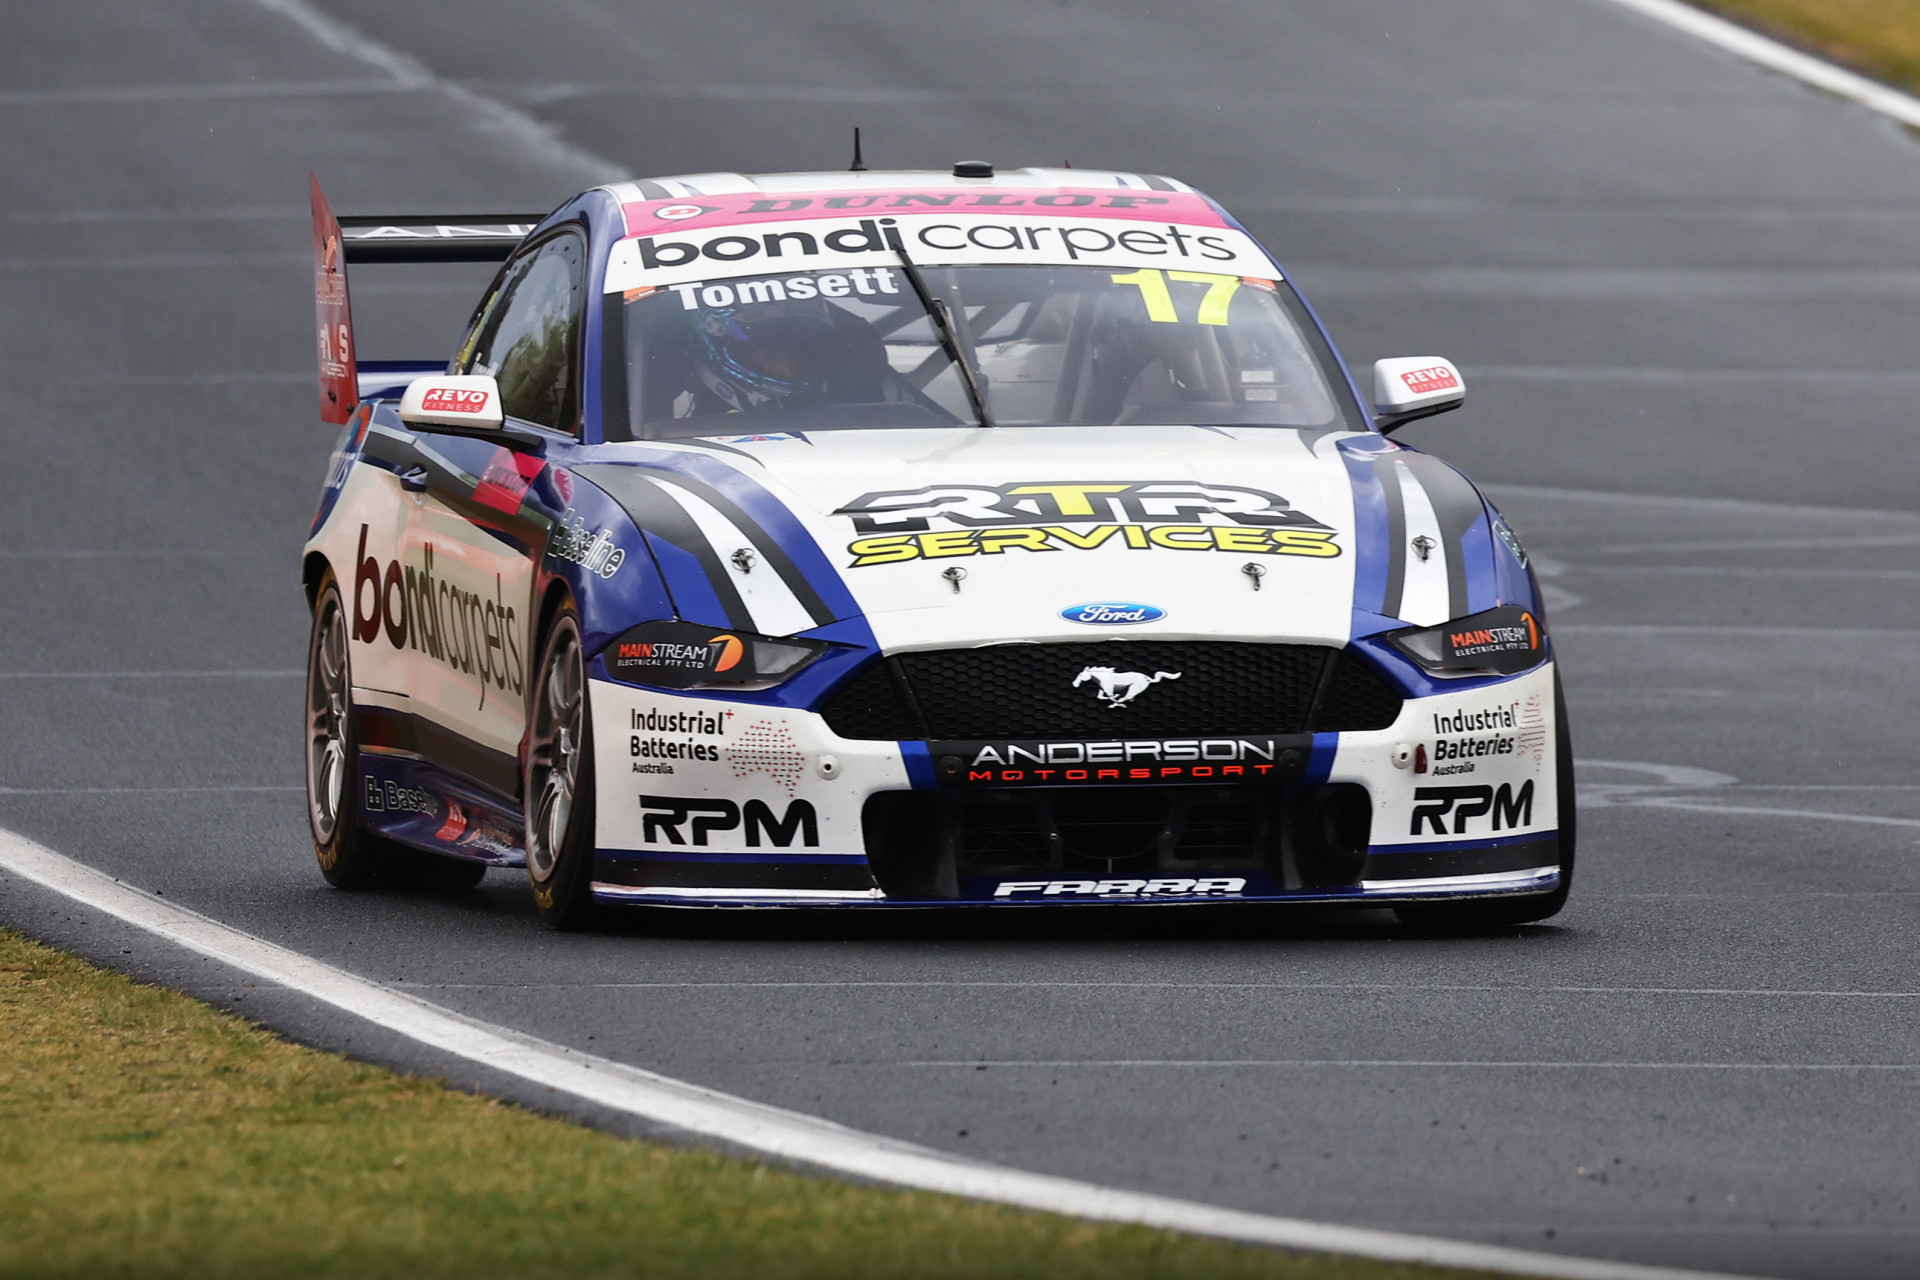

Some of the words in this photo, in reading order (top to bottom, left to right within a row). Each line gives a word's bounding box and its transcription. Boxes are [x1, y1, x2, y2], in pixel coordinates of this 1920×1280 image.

[737, 193, 1170, 214] DUNLOP
[357, 224, 538, 238] AN
[669, 268, 900, 311] Tomsett
[1110, 268, 1242, 326] 17
[1407, 367, 1450, 385] REVO
[424, 401, 481, 412] FITNESS
[427, 389, 487, 403] REVO
[829, 480, 1339, 535] RTR
[847, 524, 1342, 568] SERVICES
[1079, 604, 1146, 622] Ford
[1450, 627, 1528, 648] MAINSTREAM
[619, 643, 708, 660] MAINSTREAM
[1455, 644, 1505, 657] ELECTRICAL
[617, 659, 661, 667] ELECTRICAL
[665, 659, 682, 667] PTY
[686, 661, 705, 669] LTD
[631, 708, 724, 736] Industrial
[1433, 703, 1517, 735] Industrial
[630, 735, 719, 762] Batteries
[971, 740, 1275, 766] ANDERSON
[1434, 733, 1515, 761] Batteries
[632, 762, 674, 774] Australia
[969, 764, 1275, 781] MOTORSPORT
[1432, 761, 1475, 776] Australia
[1410, 779, 1534, 836] RPM
[639, 794, 820, 847] RPM
